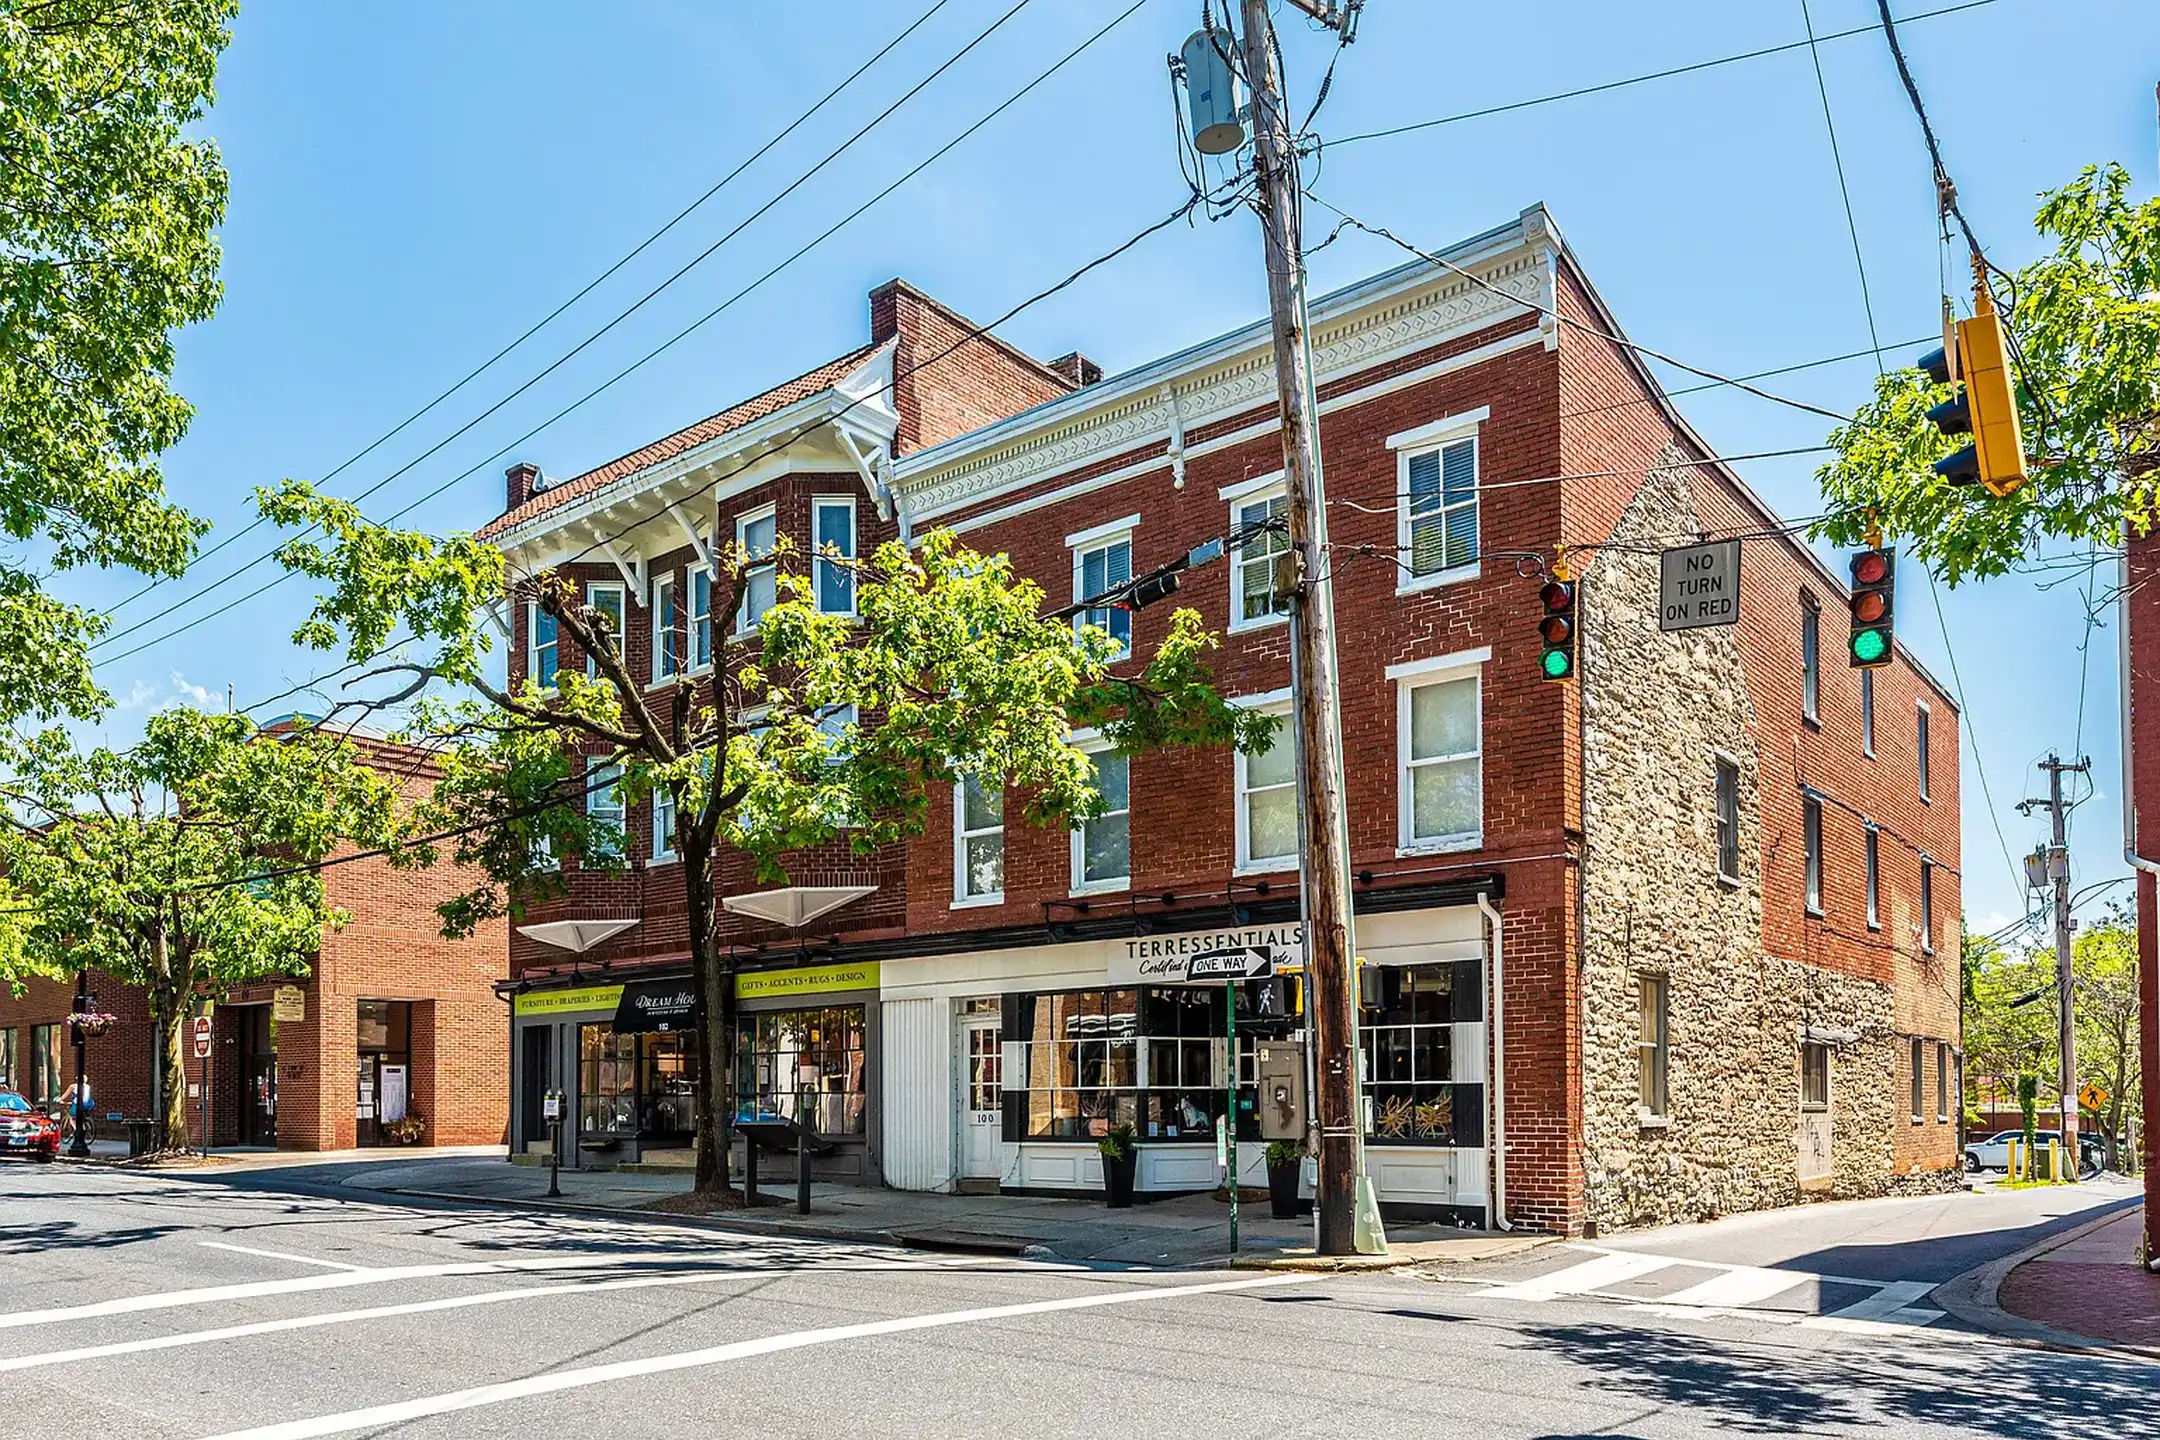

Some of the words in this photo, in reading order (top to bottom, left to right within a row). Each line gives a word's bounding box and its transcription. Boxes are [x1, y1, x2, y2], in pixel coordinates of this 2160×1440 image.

[1686, 554, 1713, 572] NO
[1677, 576, 1722, 596] TURN
[1666, 603, 1689, 620] ON
[1698, 598, 1732, 617] RED
[1125, 927, 1303, 959] TERRESSENTIALS
[1139, 958, 1184, 977] Certified
[1196, 958, 1219, 972] ONE
[1223, 955, 1248, 970] WAY
[741, 980, 764, 991] GIFTS
[767, 975, 804, 988] ACCENTS
[808, 973, 830, 985] RUGS
[835, 971, 867, 982] DESIGN
[521, 998, 554, 1009] FURNITURE
[558, 994, 590, 1005] DRAPERIES
[596, 992, 622, 1002] LIGHTIN
[977, 1114, 994, 1123] 100
